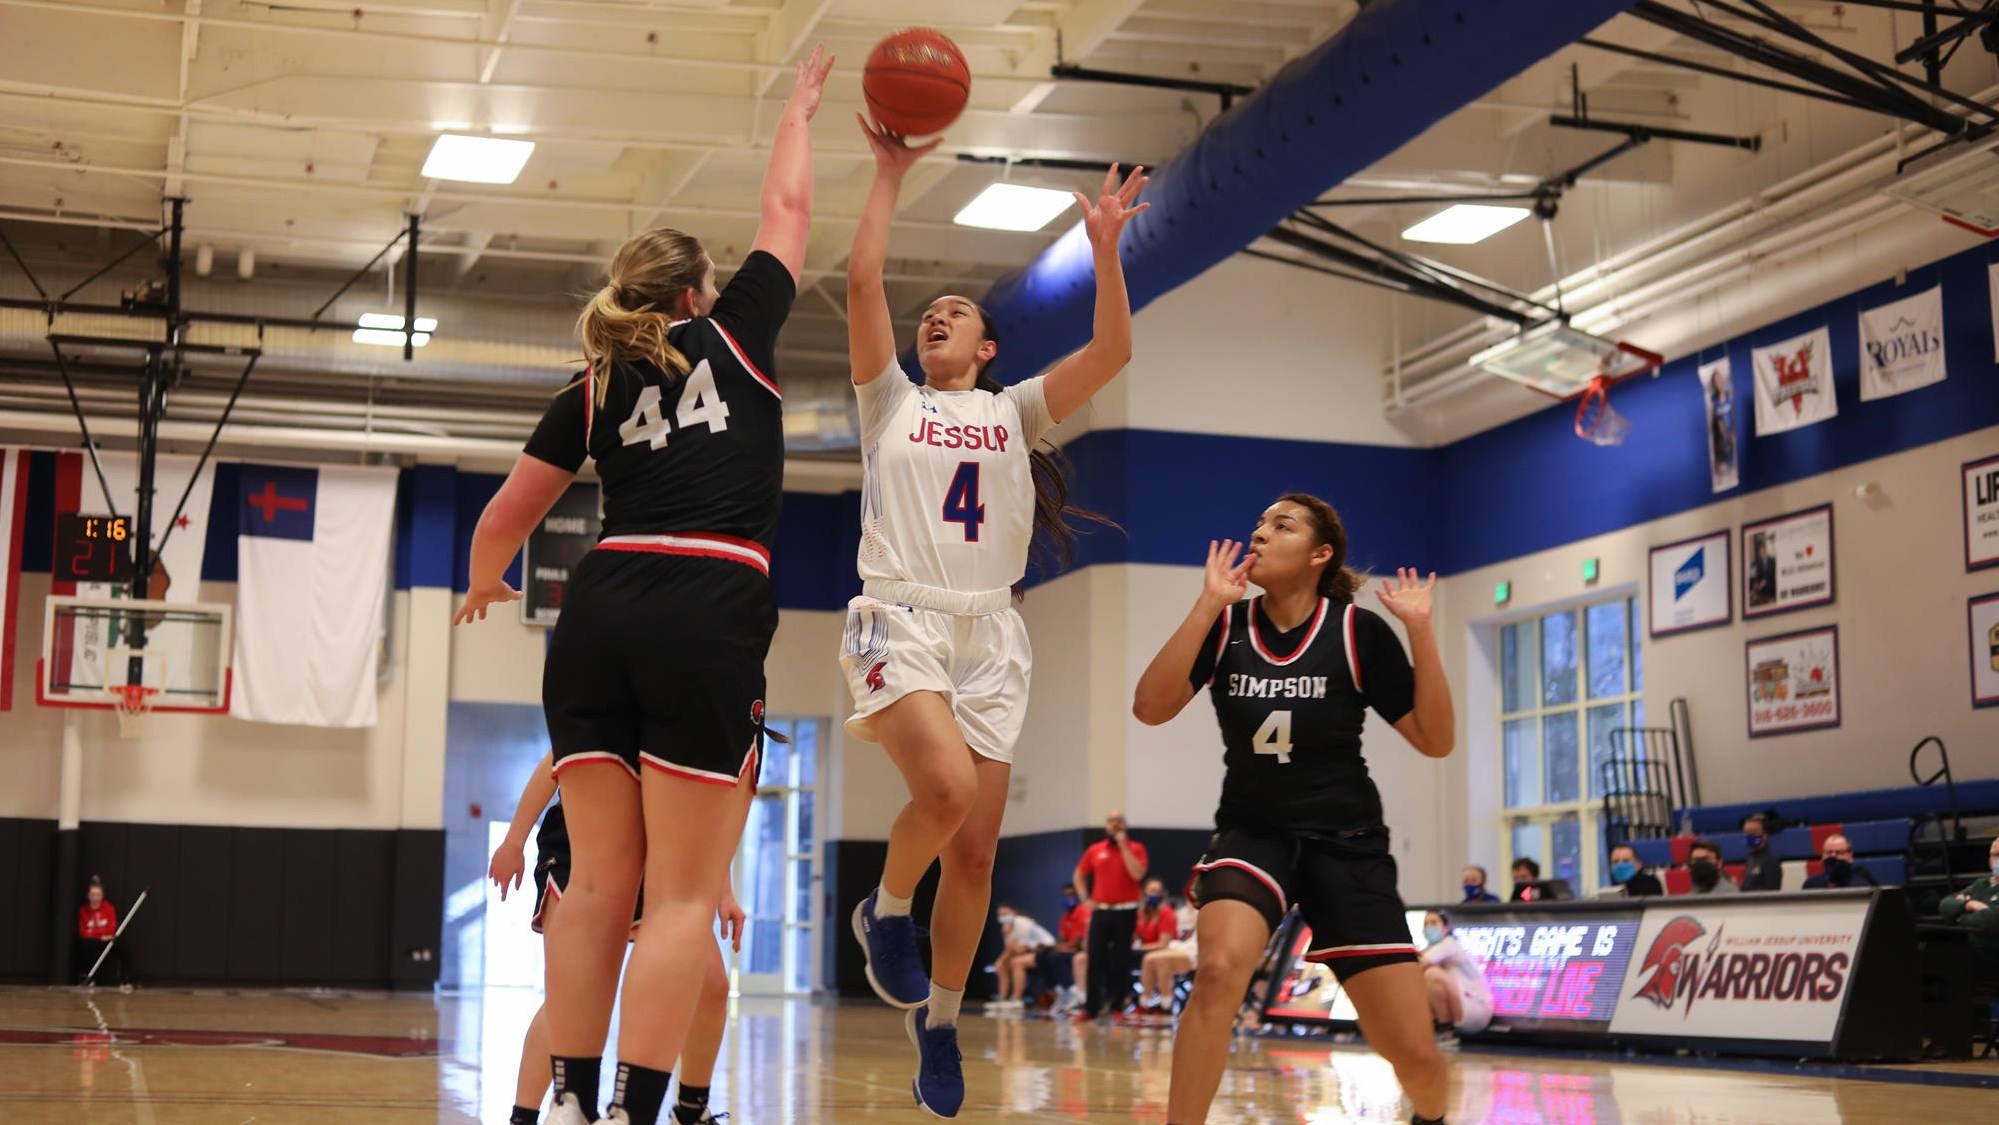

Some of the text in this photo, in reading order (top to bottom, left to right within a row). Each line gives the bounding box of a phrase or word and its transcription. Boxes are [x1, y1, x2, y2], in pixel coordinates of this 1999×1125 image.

[1866, 328, 1940, 368] ROYALS
[618, 358, 730, 452] 44
[908, 417, 1009, 452] JESSUP
[942, 461, 985, 543] 4
[86, 518, 127, 541] 1:16
[544, 517, 587, 534] HOME
[1229, 673, 1327, 699] SIMPSON
[1252, 710, 1293, 764] 4
[1529, 926, 1588, 957] GAME
[1591, 925, 1618, 957] IS
[1726, 934, 1852, 946] WILLIAM JESSUP UNIVERSITY
[1676, 951, 1849, 1010] WARRIORS
